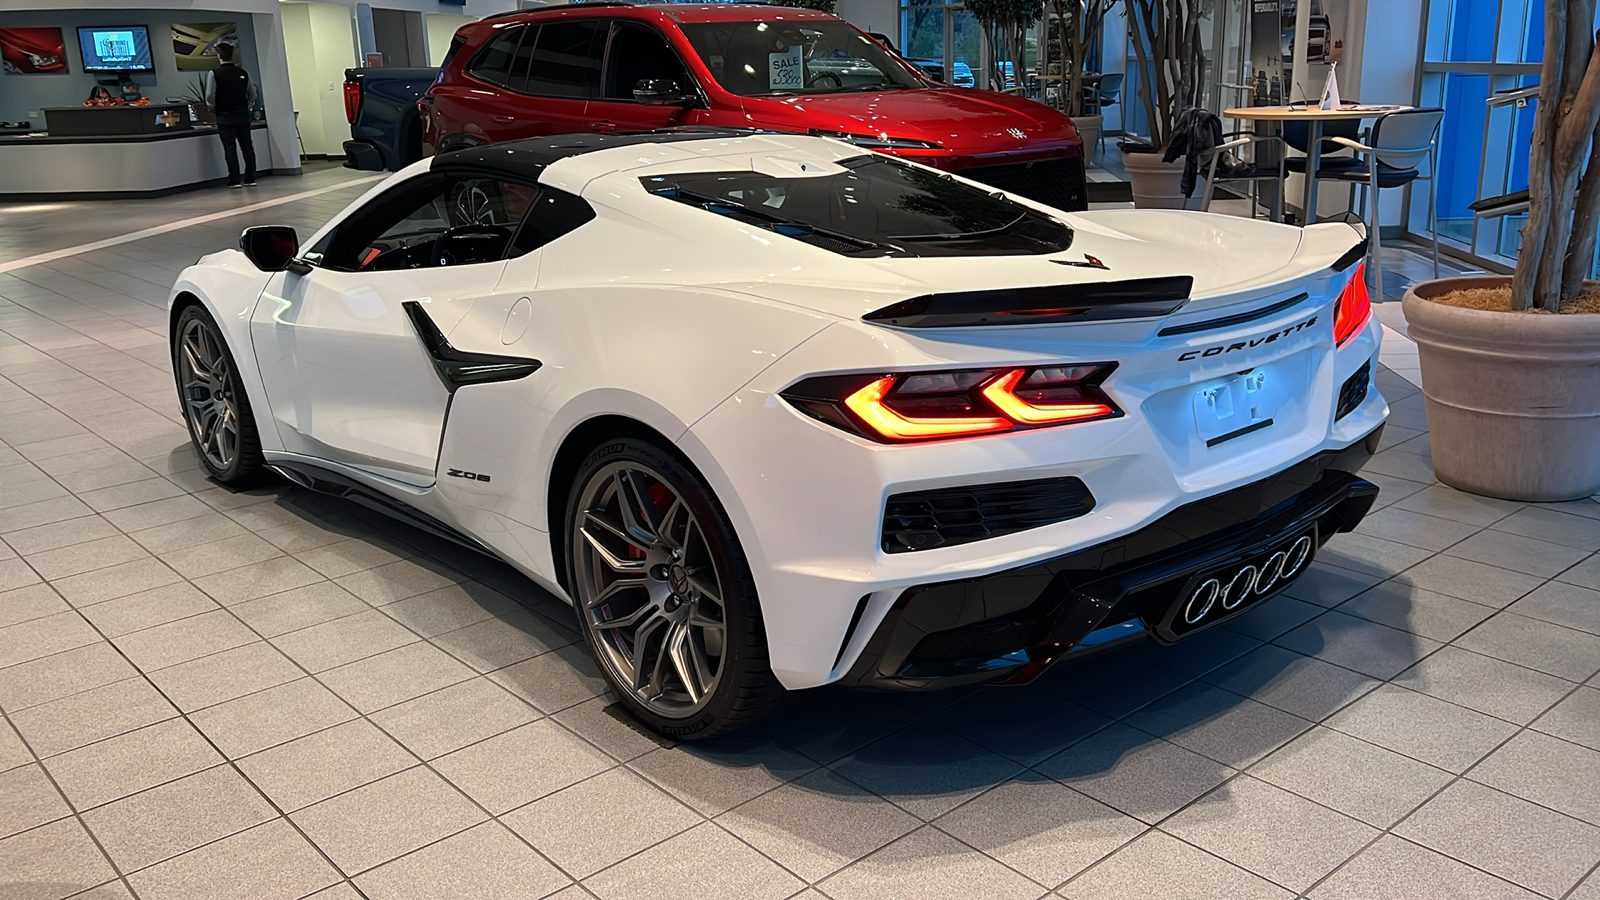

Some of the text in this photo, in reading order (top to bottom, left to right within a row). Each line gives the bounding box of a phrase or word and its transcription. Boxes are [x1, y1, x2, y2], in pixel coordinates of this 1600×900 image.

[773, 56, 799, 69] SALE
[1178, 316, 1318, 361] CORVETTE
[447, 468, 490, 482] Z06
